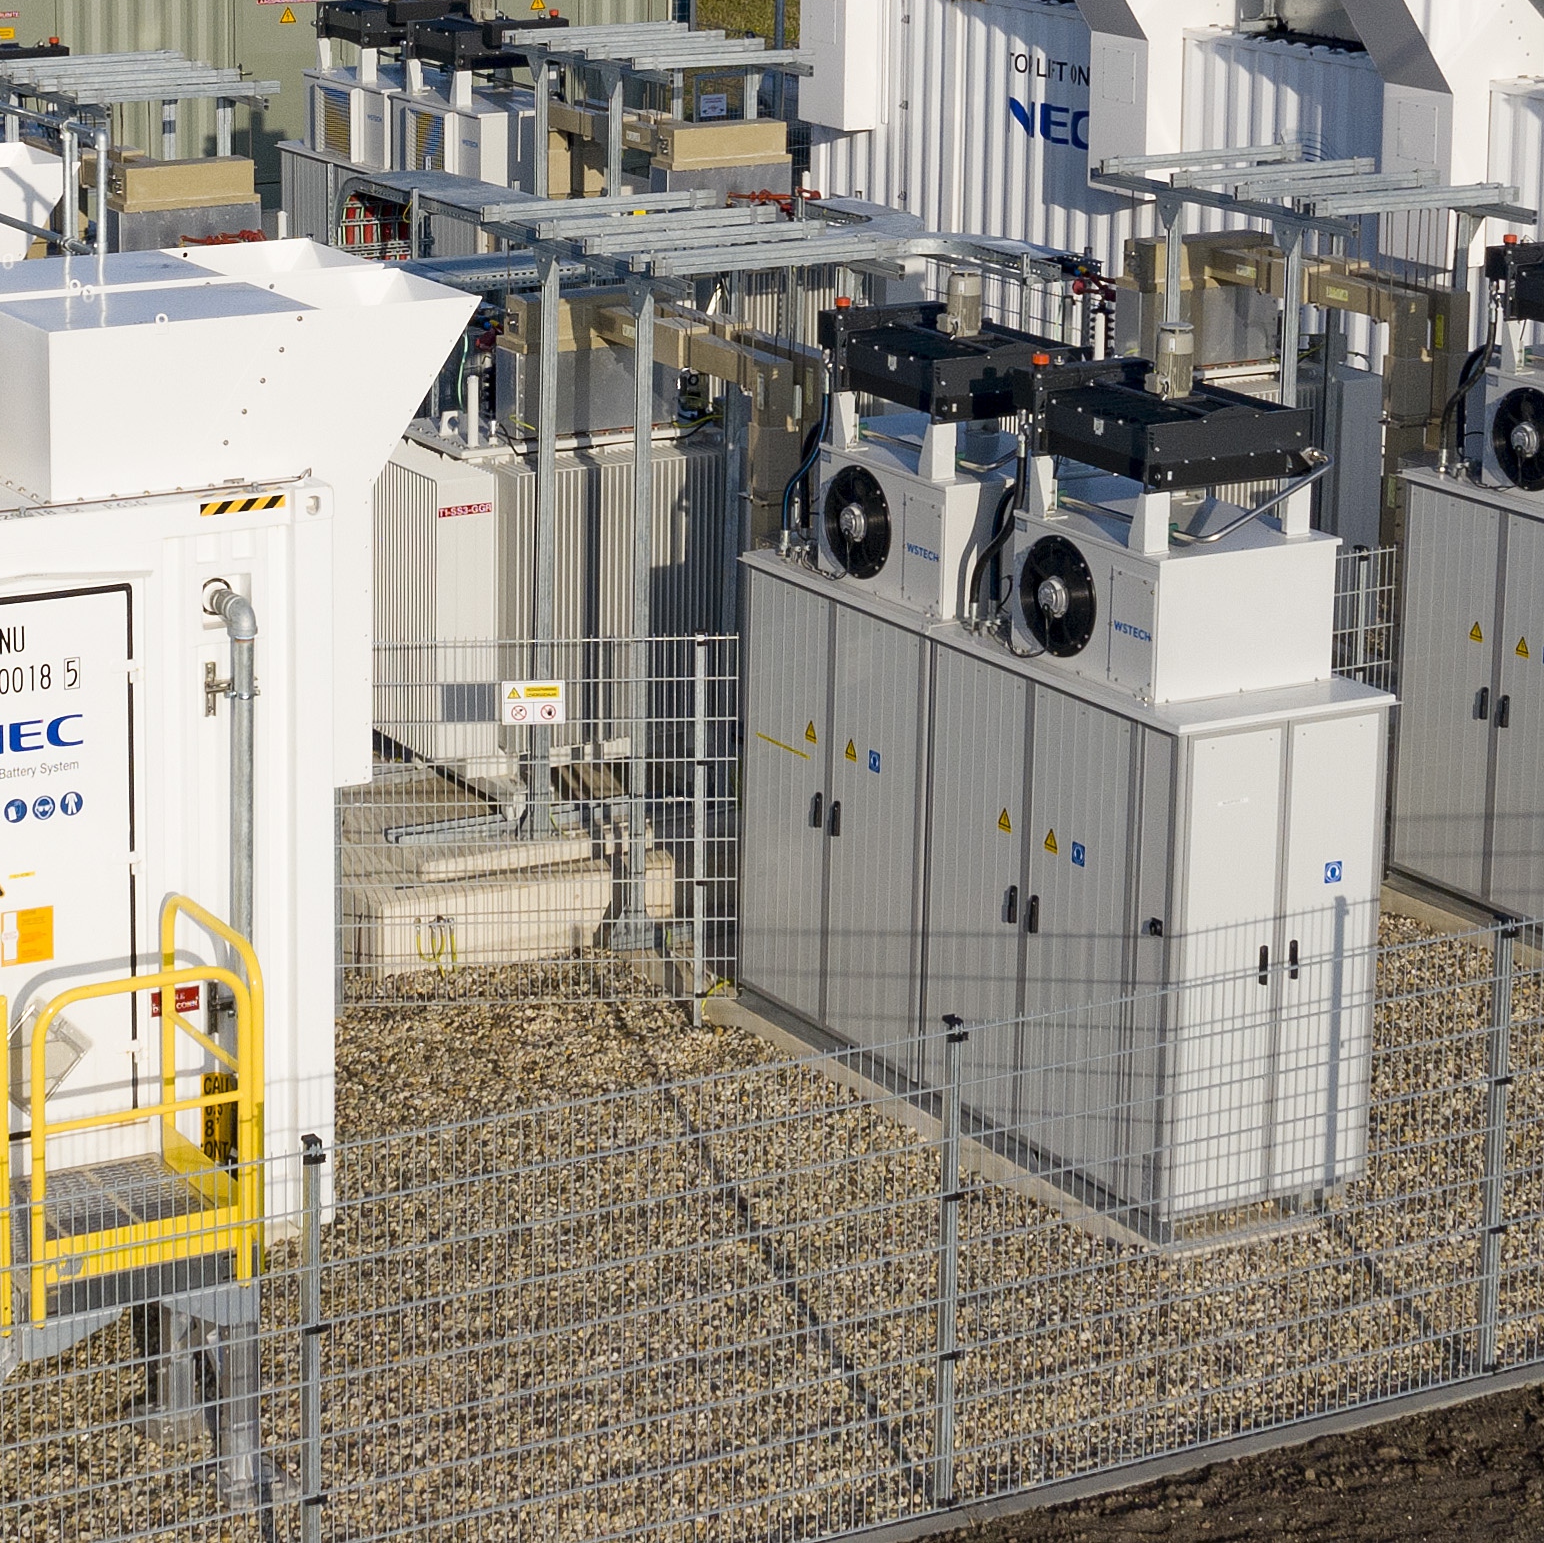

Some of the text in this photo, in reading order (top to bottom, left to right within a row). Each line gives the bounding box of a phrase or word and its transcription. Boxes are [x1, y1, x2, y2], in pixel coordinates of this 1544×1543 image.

[906, 542, 939, 562] WSTECH
[1113, 619, 1152, 643] WSTECH
[65, 659, 79, 689] 5
[0, 765, 37, 779] Battery
[40, 760, 80, 775] System
